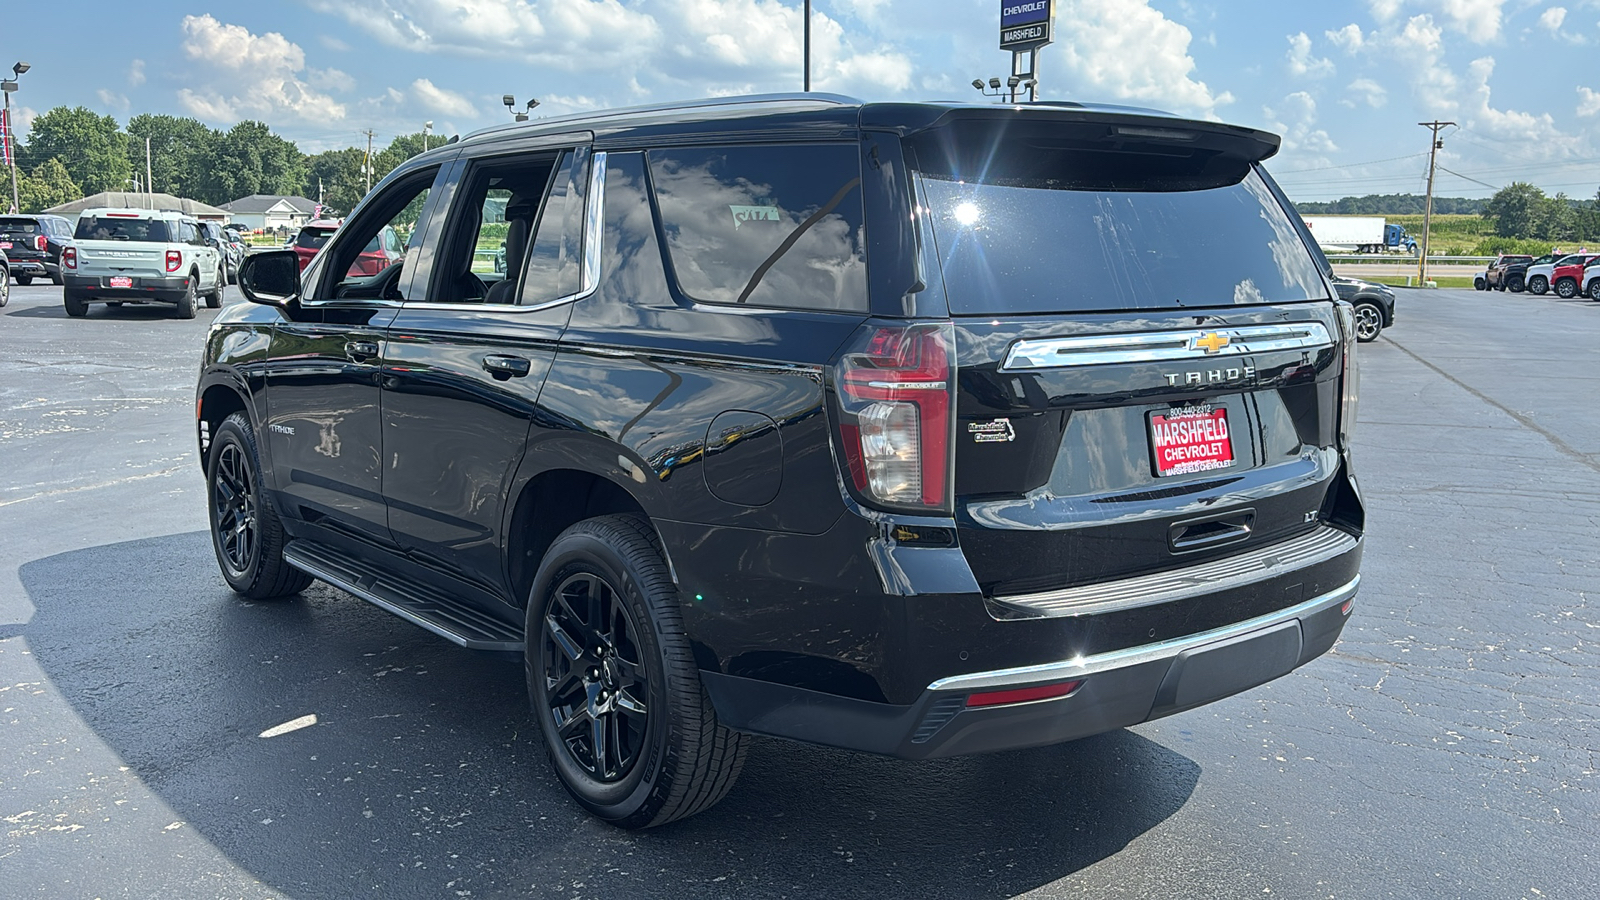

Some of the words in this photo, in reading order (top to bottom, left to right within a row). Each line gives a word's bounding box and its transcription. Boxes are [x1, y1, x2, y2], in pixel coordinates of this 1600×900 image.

[1003, 1, 1046, 16] CHEVROLET
[1004, 27, 1042, 42] MARSHFIELD
[1164, 366, 1255, 386] TAHOE
[1170, 404, 1211, 417] 800-440-2312
[270, 424, 295, 435] TAHOE
[1153, 418, 1228, 447] MARSHFIELD
[1164, 442, 1223, 461] CHEVROLET
[1165, 463, 1200, 476] MARSHFIELD
[1200, 460, 1231, 471] CHEVROLET
[1304, 510, 1318, 523] LT
